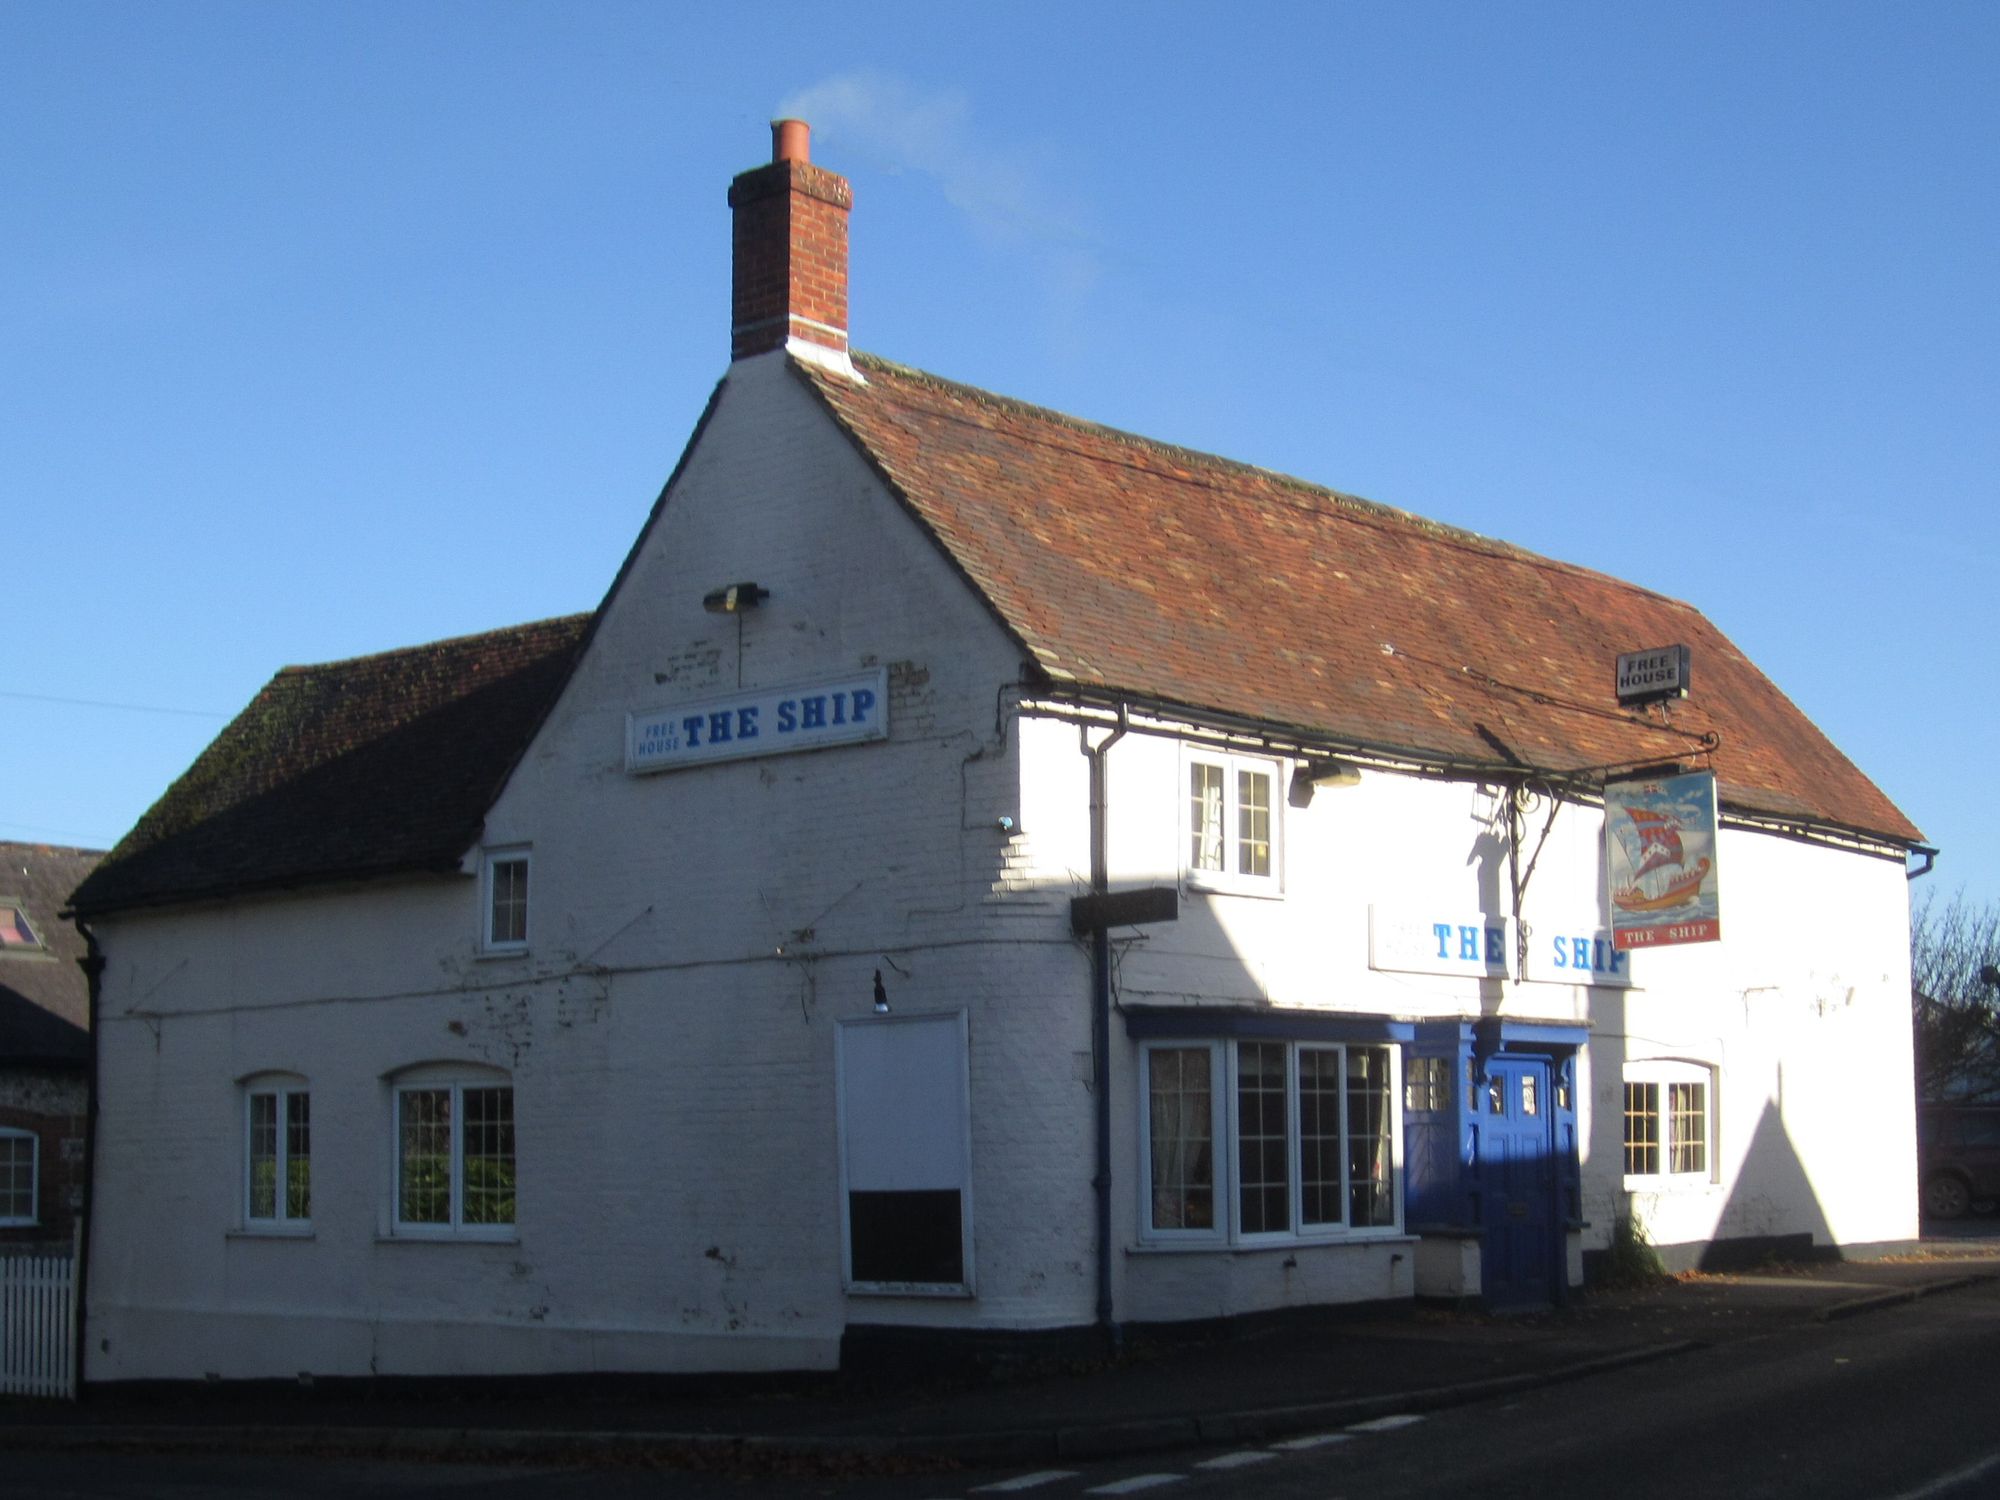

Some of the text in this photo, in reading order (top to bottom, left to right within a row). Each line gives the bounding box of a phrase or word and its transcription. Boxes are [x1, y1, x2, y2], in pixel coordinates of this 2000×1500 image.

[1628, 655, 1669, 673] FREE
[1620, 668, 1676, 688] HOUSE
[683, 689, 876, 748] THE SHIP
[645, 721, 675, 738] FREE
[638, 737, 680, 756] HOUSE
[1433, 923, 1505, 964] THE
[1624, 924, 1708, 945] THE SHIP
